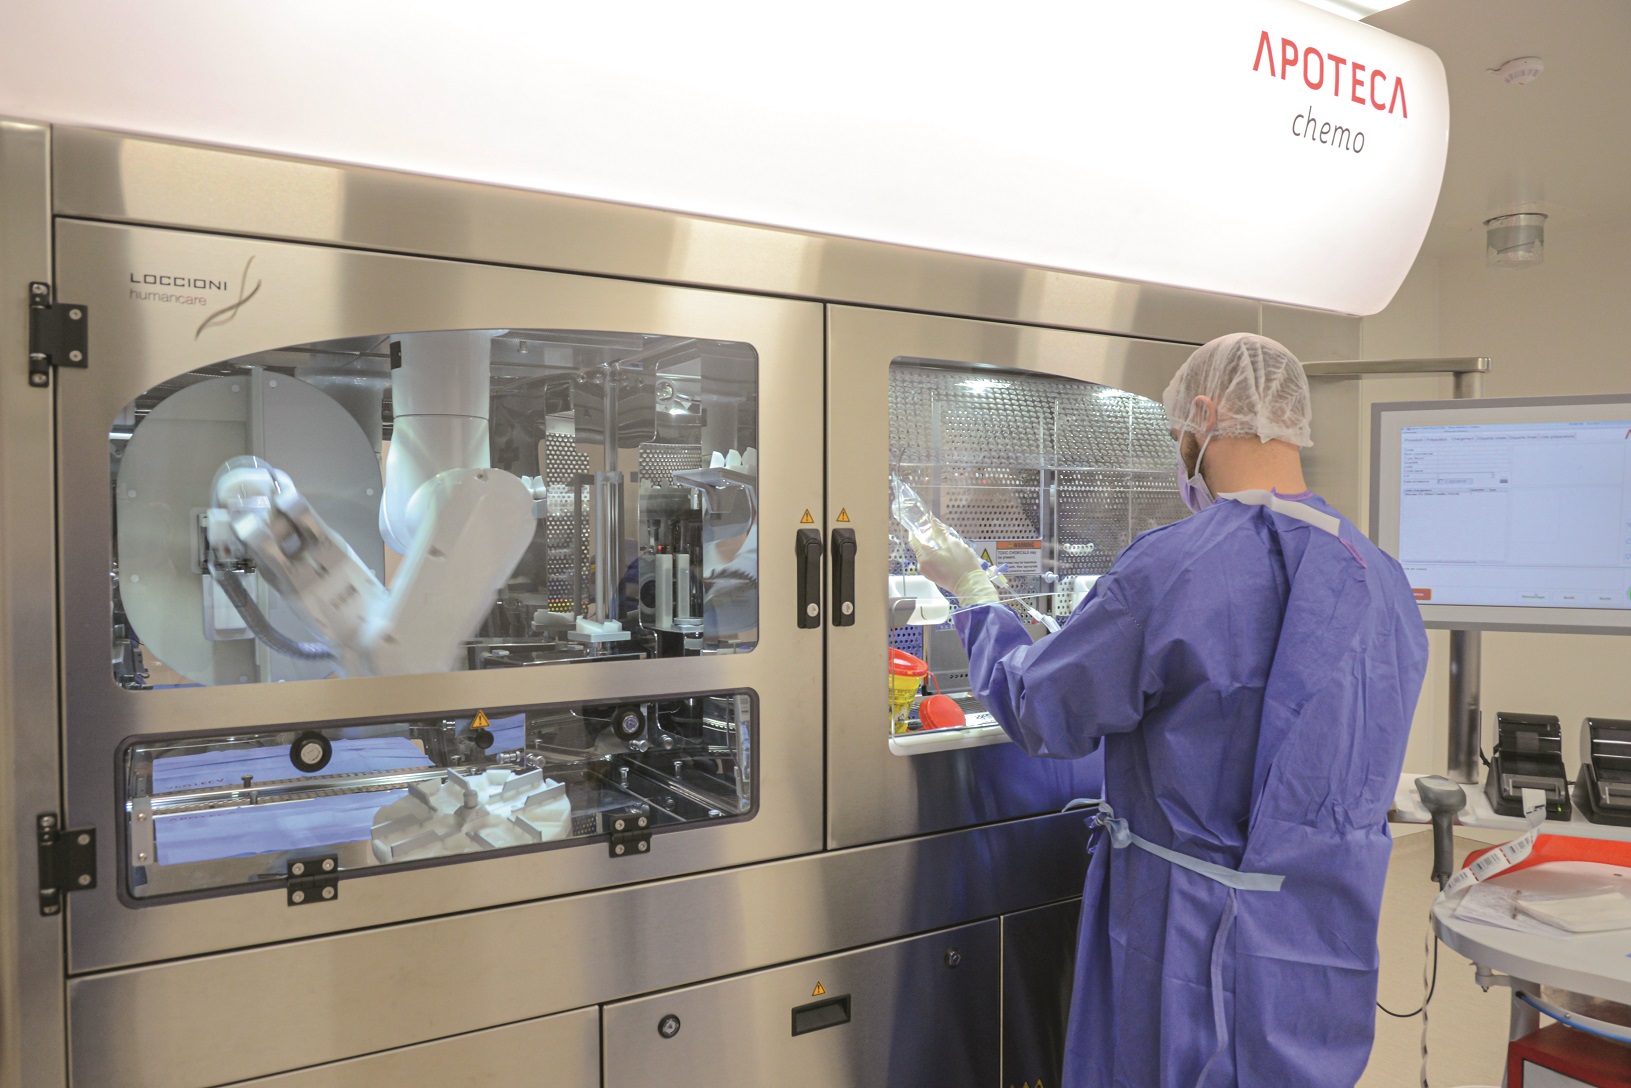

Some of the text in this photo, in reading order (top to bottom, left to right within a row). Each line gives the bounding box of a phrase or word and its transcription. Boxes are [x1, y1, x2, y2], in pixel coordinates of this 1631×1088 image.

[1252, 30, 1408, 119] APOTECA
[1292, 105, 1365, 154] chemo
[129, 288, 207, 306] humancare
[130, 273, 227, 291] LOCCIONI
